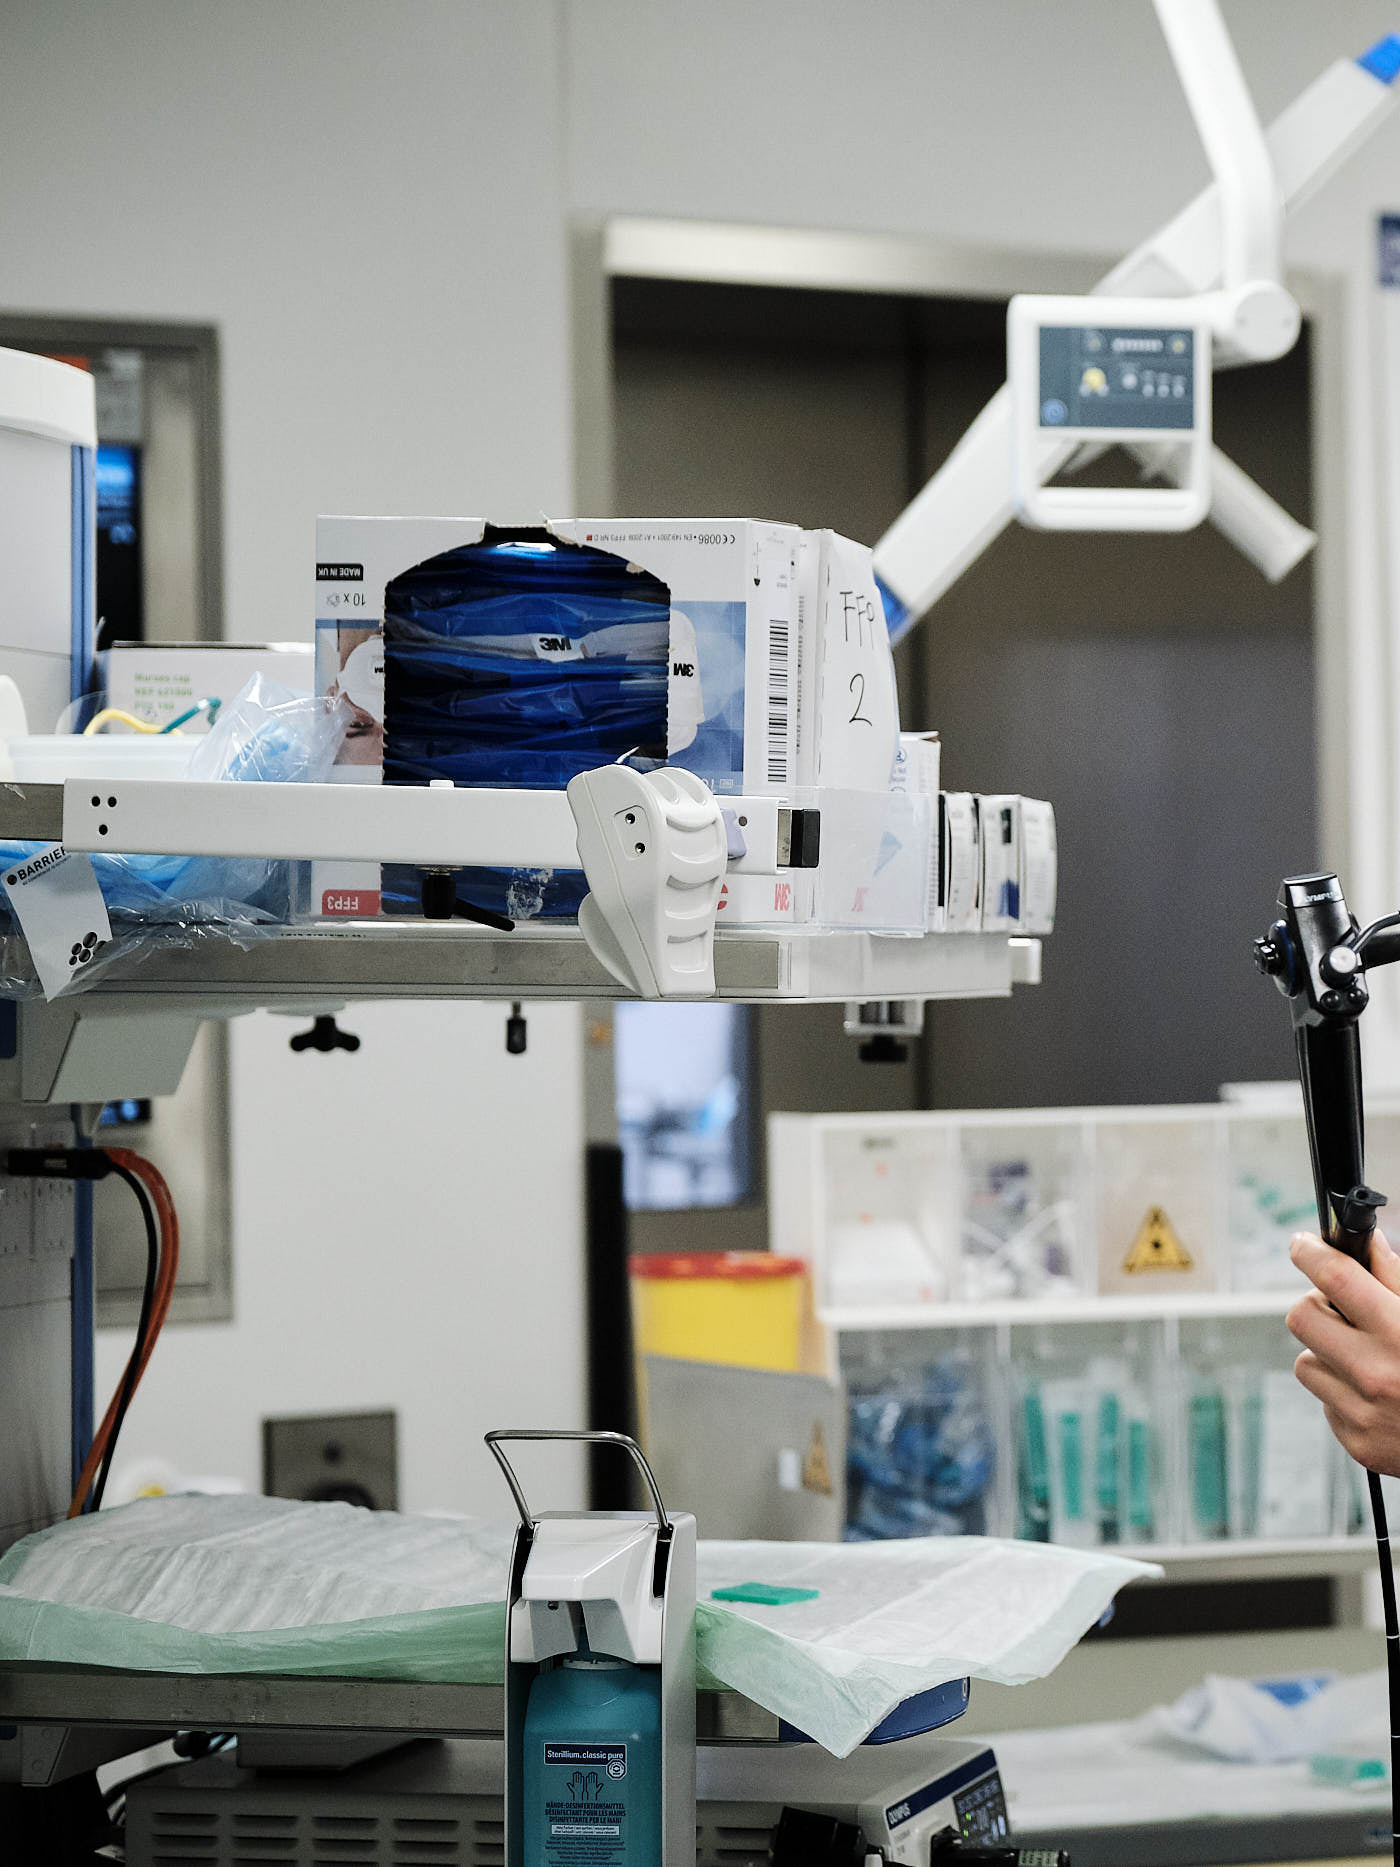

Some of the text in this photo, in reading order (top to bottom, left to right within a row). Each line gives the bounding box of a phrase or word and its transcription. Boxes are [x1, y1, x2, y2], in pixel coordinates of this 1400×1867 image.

[698, 534, 721, 545] 0086
[318, 568, 361, 577] MADE IN UK
[353, 593, 366, 606] 10
[539, 637, 572, 651] 3M
[673, 662, 695, 677] 3M
[849, 673, 873, 727] 2
[327, 896, 359, 910] FFP3
[774, 883, 792, 911] 3M
[1304, 891, 1337, 902] LYMPU
[582, 1751, 607, 1759] classic
[607, 1752, 624, 1760] pure
